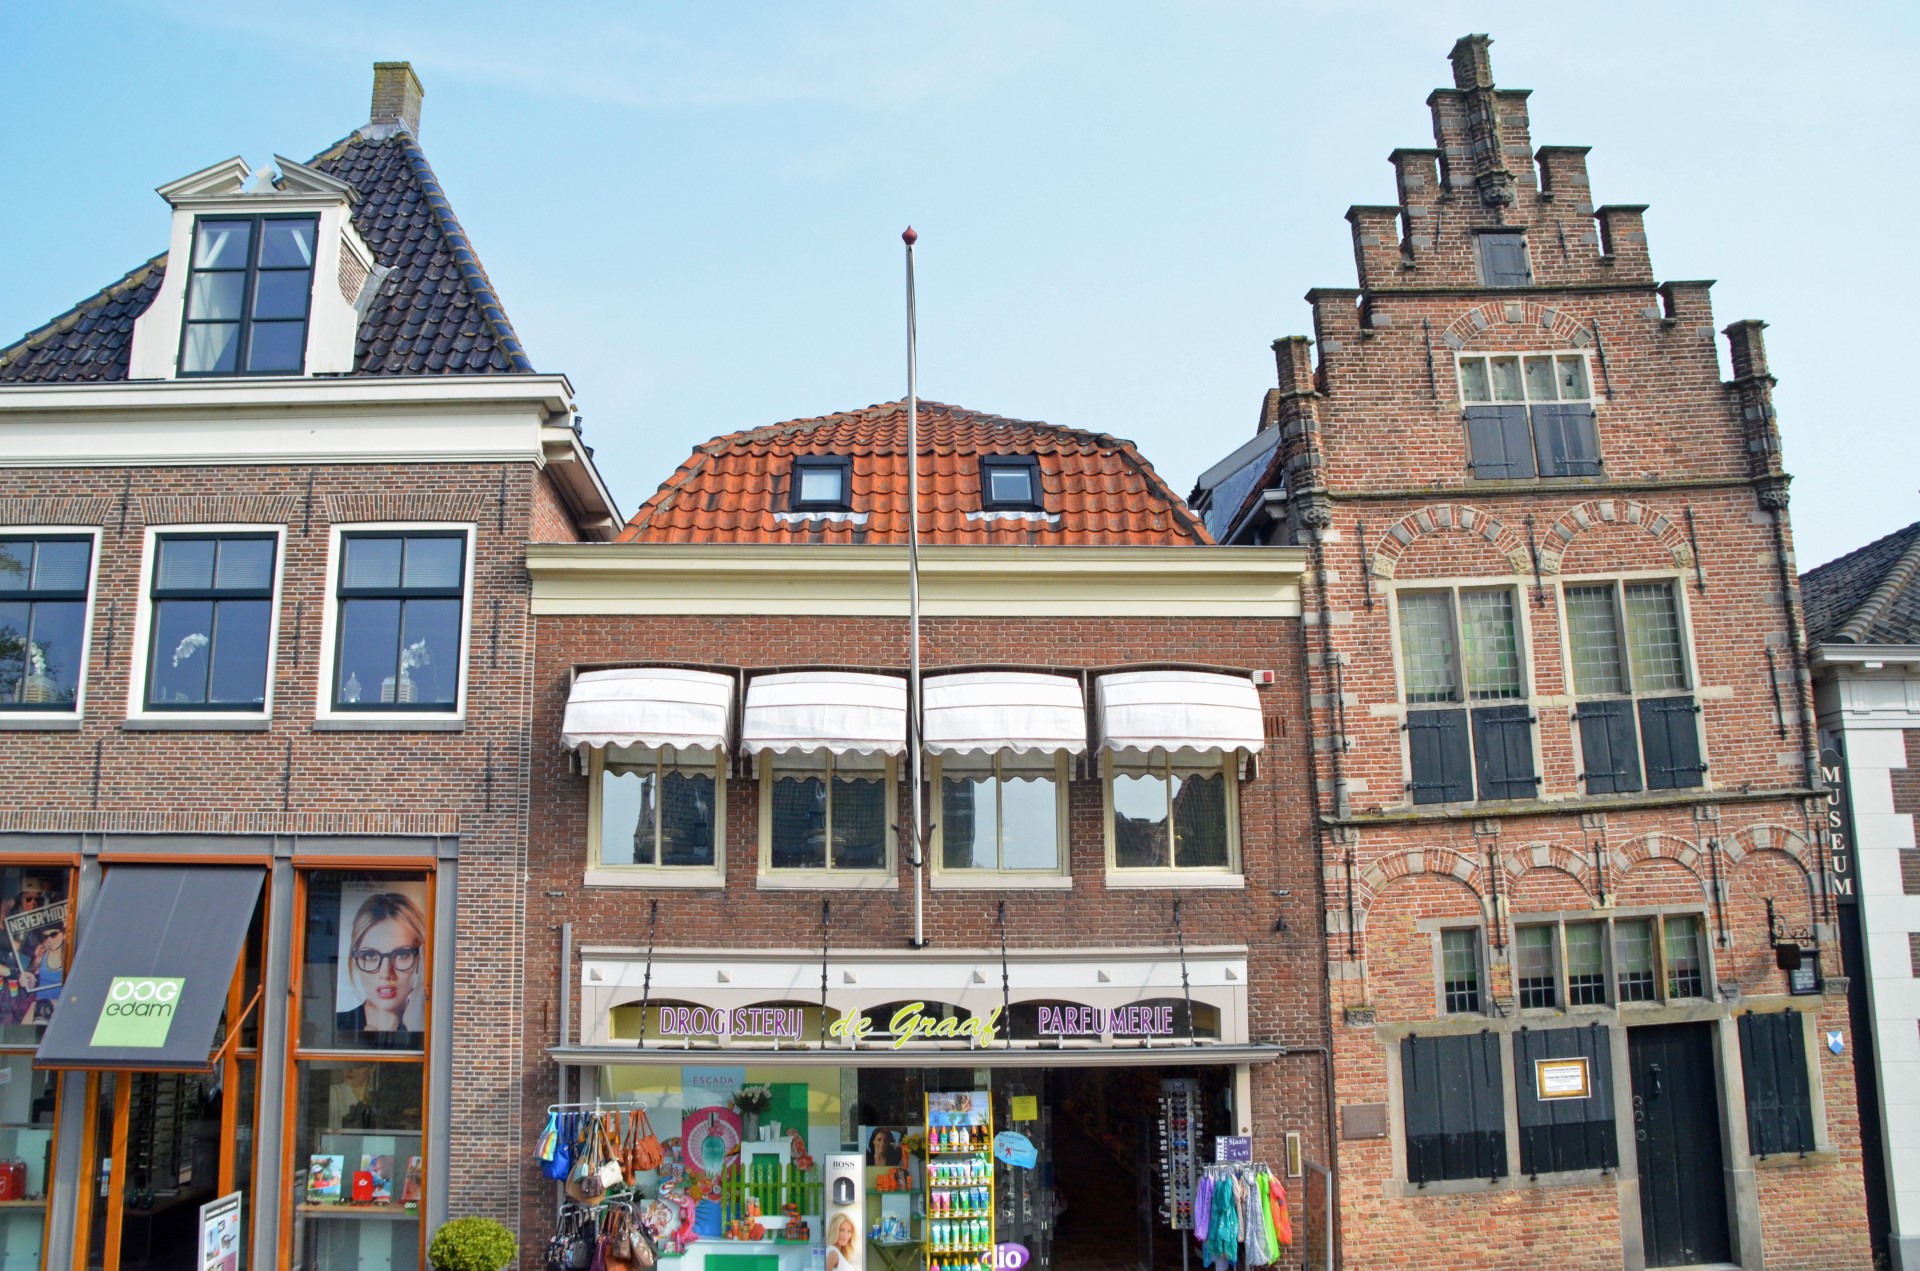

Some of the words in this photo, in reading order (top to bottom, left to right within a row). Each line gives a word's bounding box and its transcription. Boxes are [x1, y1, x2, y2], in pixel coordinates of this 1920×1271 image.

[1821, 766, 1853, 896] MUSEUM
[10, 912, 45, 933] NEVER
[111, 980, 178, 1002] OOG
[106, 1001, 172, 1017] edam
[660, 1007, 803, 1041] DROGISTERIJ
[829, 1006, 873, 1037] de
[889, 1001, 1003, 1049] Graaf
[1038, 1006, 1173, 1035] PARFUMERIE
[692, 1076, 734, 1085] ESCADA
[832, 1160, 855, 1168] BOSS
